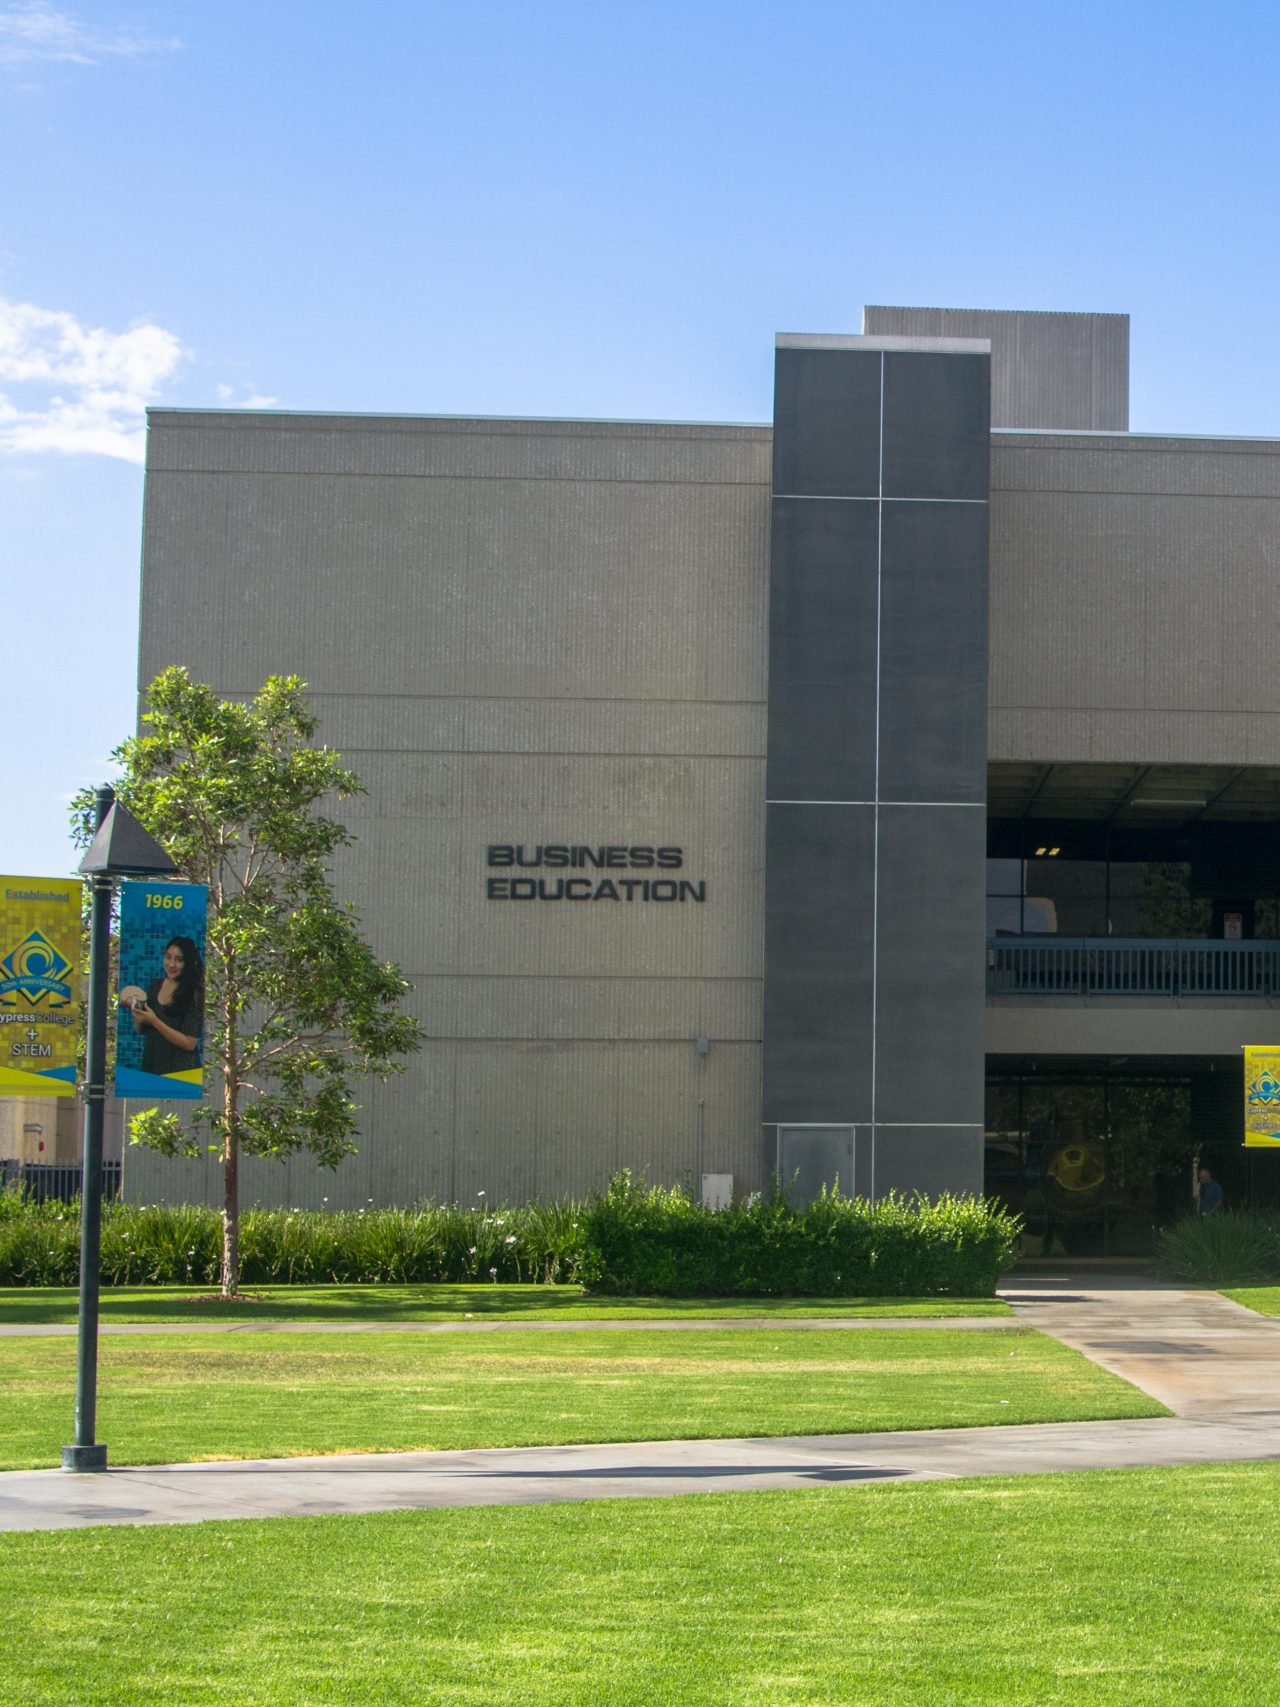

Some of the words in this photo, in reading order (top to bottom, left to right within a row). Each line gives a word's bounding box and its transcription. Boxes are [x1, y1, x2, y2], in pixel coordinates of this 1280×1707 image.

[487, 844, 683, 869] BUSINESS
[5, 888, 70, 902] Established
[486, 877, 706, 902] EDUCATION
[145, 893, 184, 910] 1966
[0, 1012, 75, 1026] ypressCollege
[12, 1043, 51, 1056] STEM
